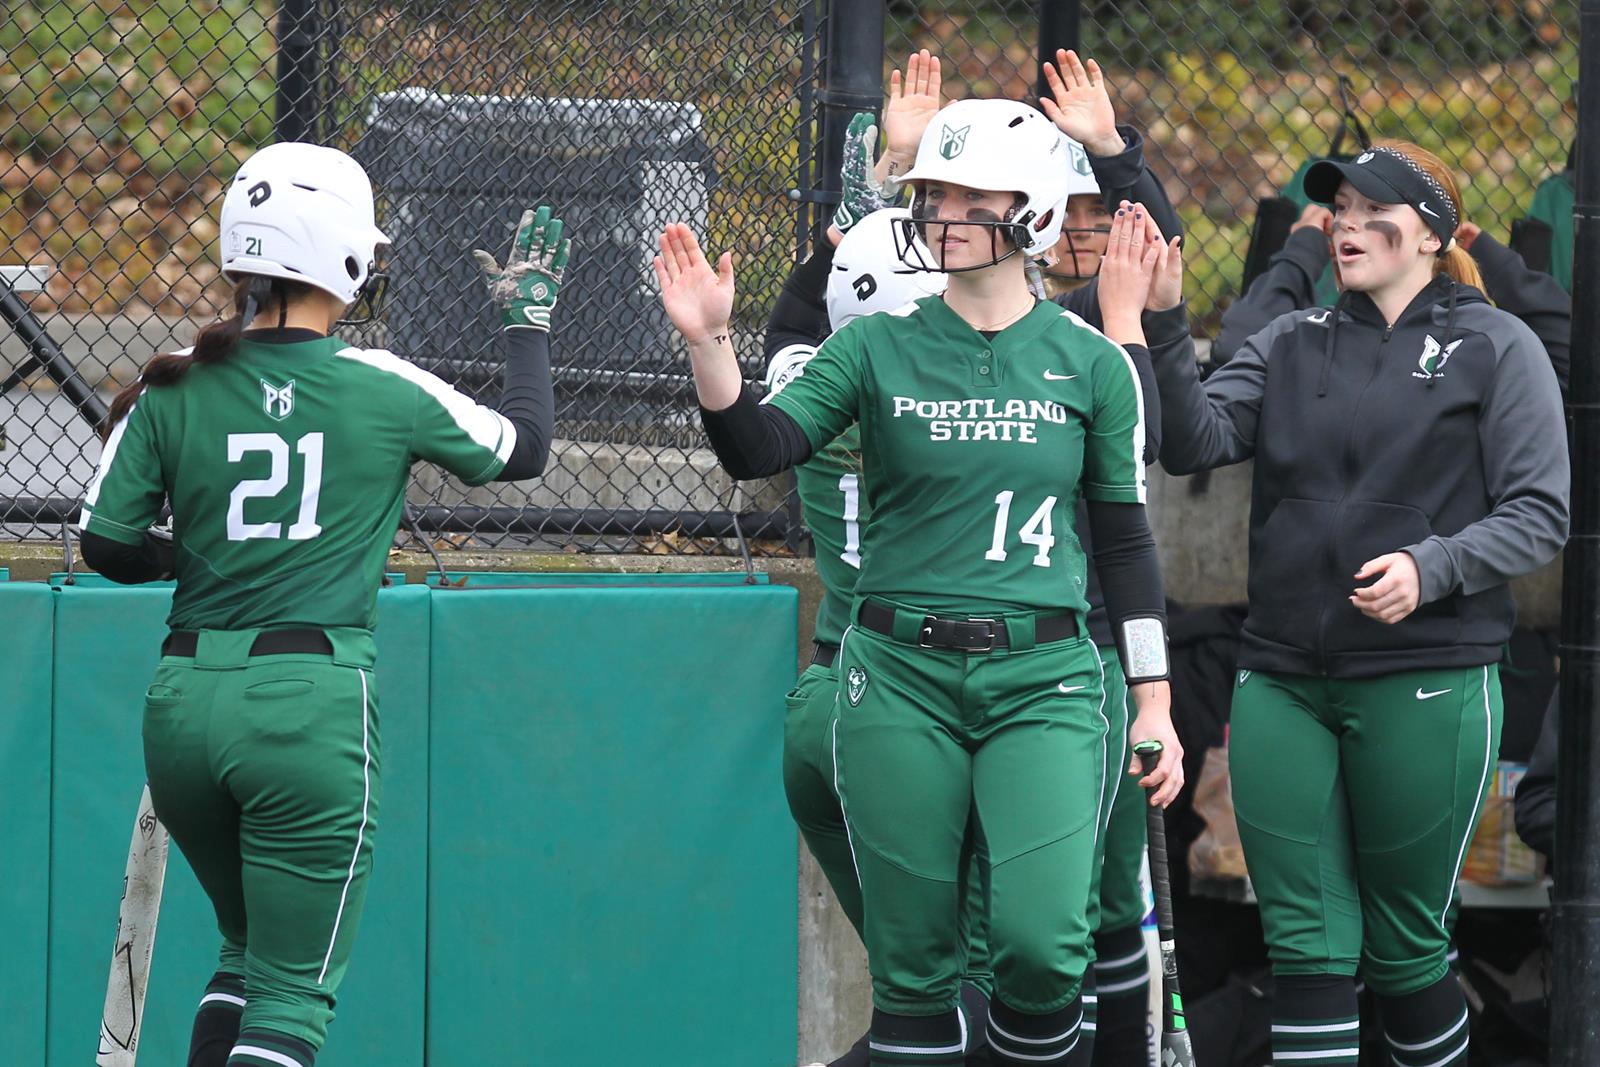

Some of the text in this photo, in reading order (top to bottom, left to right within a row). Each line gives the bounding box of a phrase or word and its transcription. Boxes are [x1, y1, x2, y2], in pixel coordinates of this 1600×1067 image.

[245, 236, 262, 256] 21
[893, 396, 1067, 424] PORTLAND
[930, 420, 1037, 443] STATE
[227, 432, 324, 541] 21
[985, 490, 1057, 567] 14
